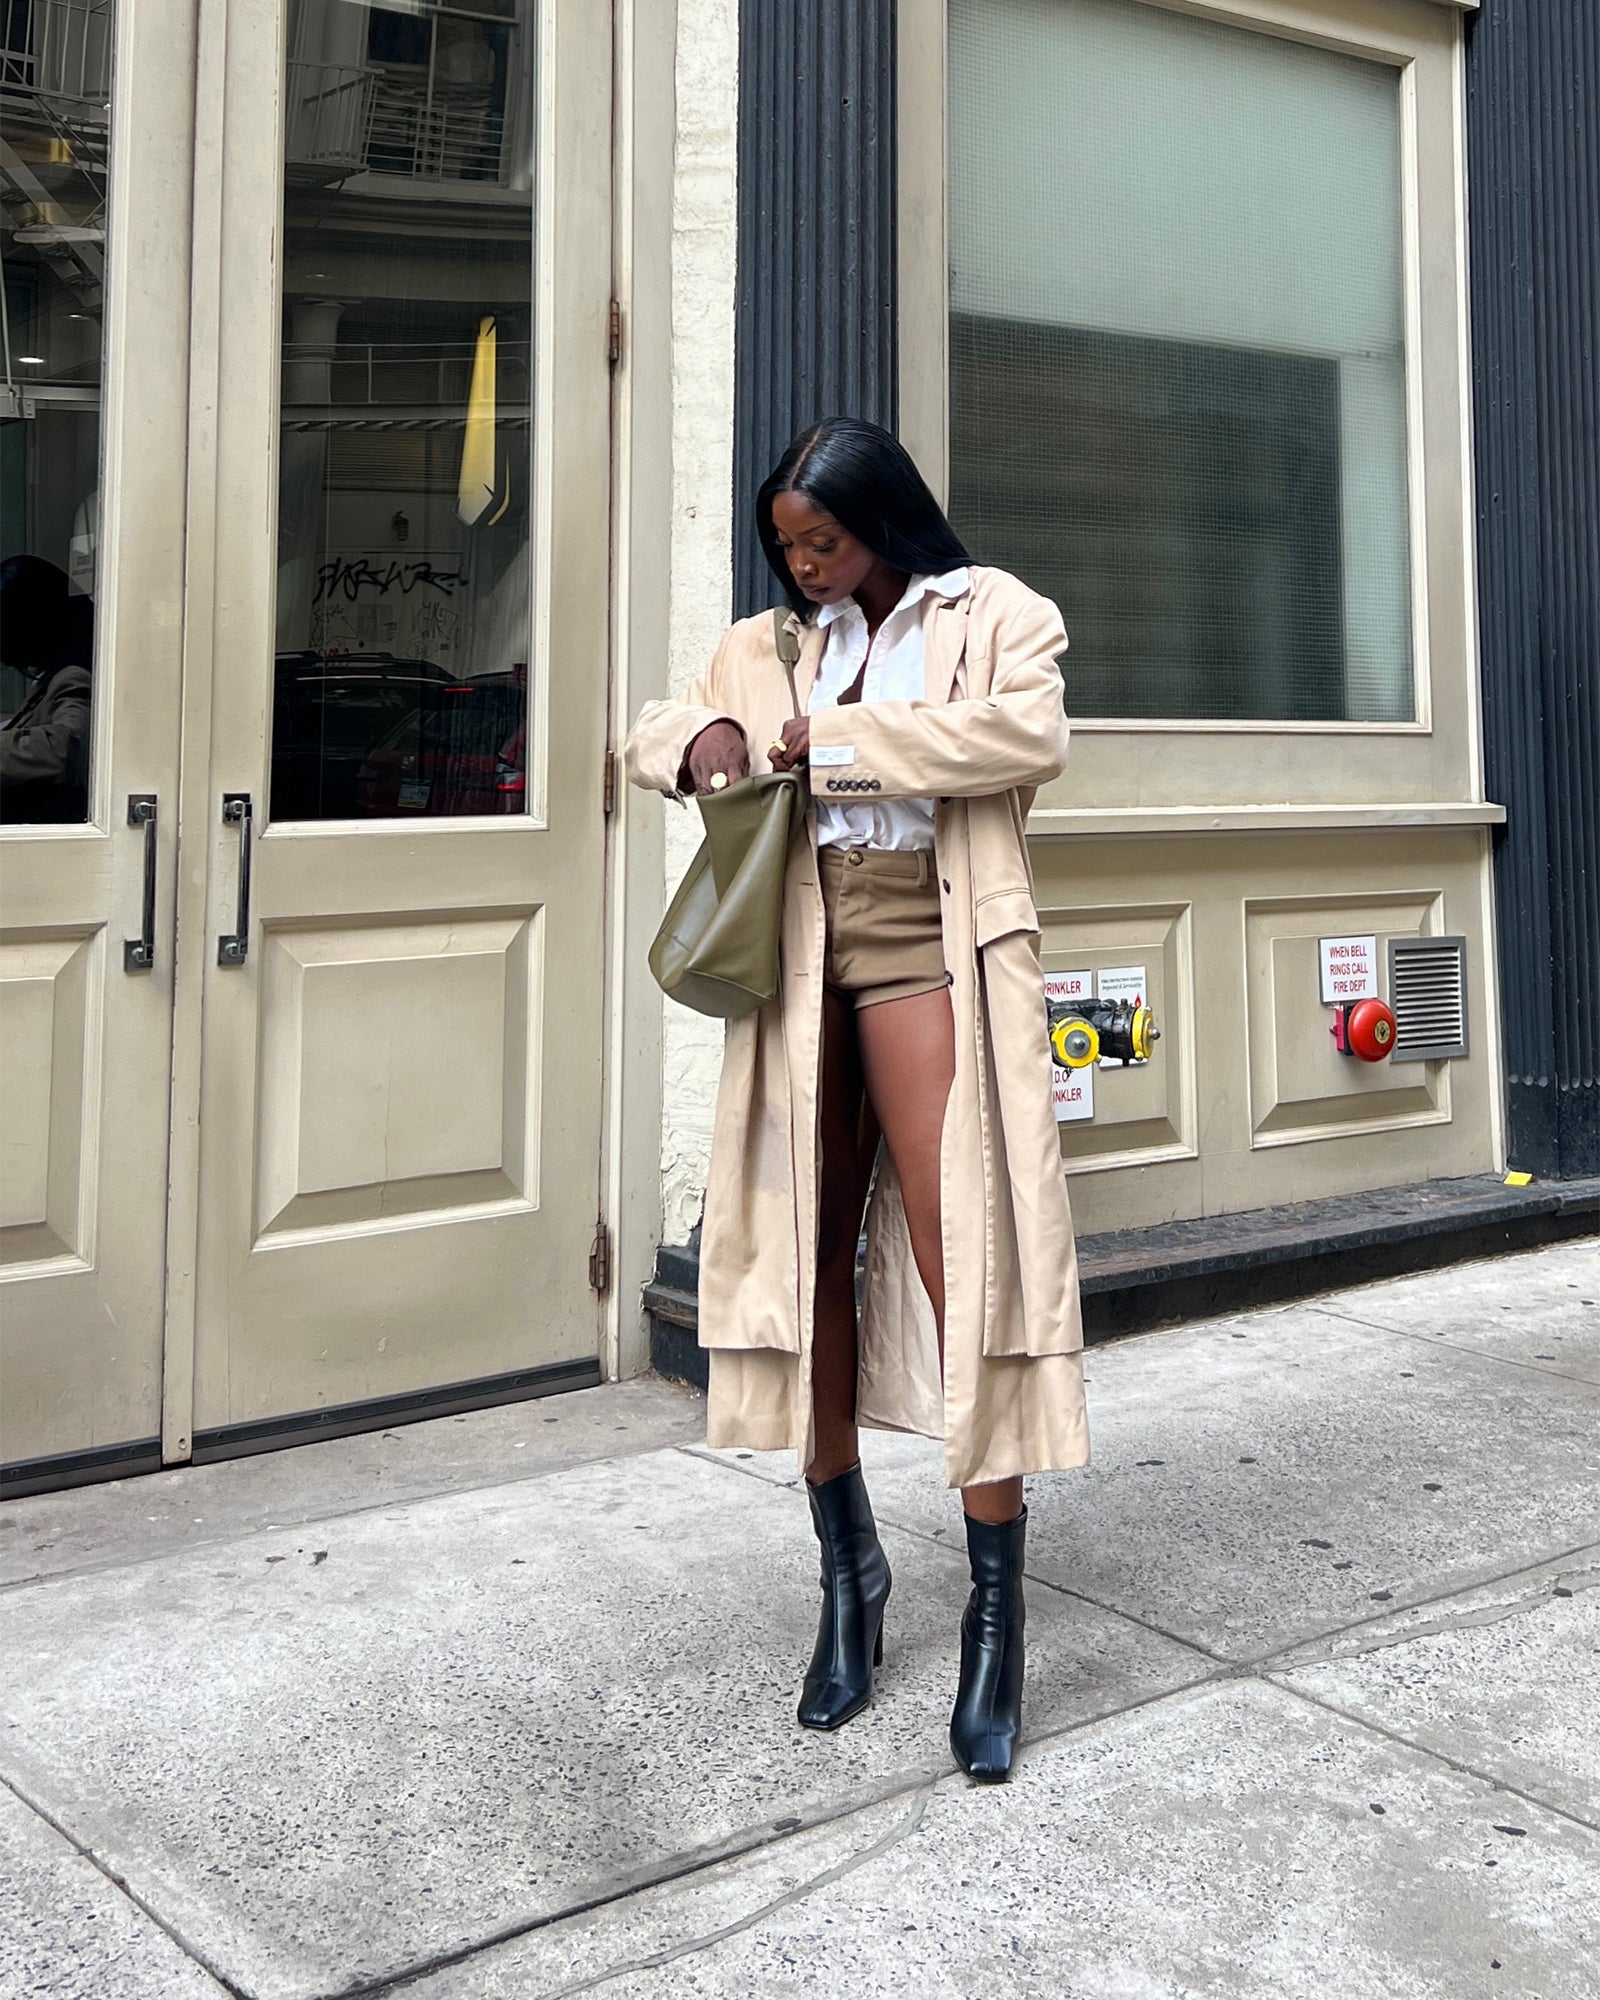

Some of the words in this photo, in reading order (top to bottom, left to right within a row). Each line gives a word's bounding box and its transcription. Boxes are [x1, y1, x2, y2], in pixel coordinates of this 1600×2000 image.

[1329, 946, 1350, 958] WHEN
[1351, 944, 1367, 957] BELL
[1330, 963, 1351, 976] RINGS
[1352, 961, 1368, 974] CALL
[1334, 980, 1348, 993] FIRE
[1349, 979, 1366, 992] DEPT
